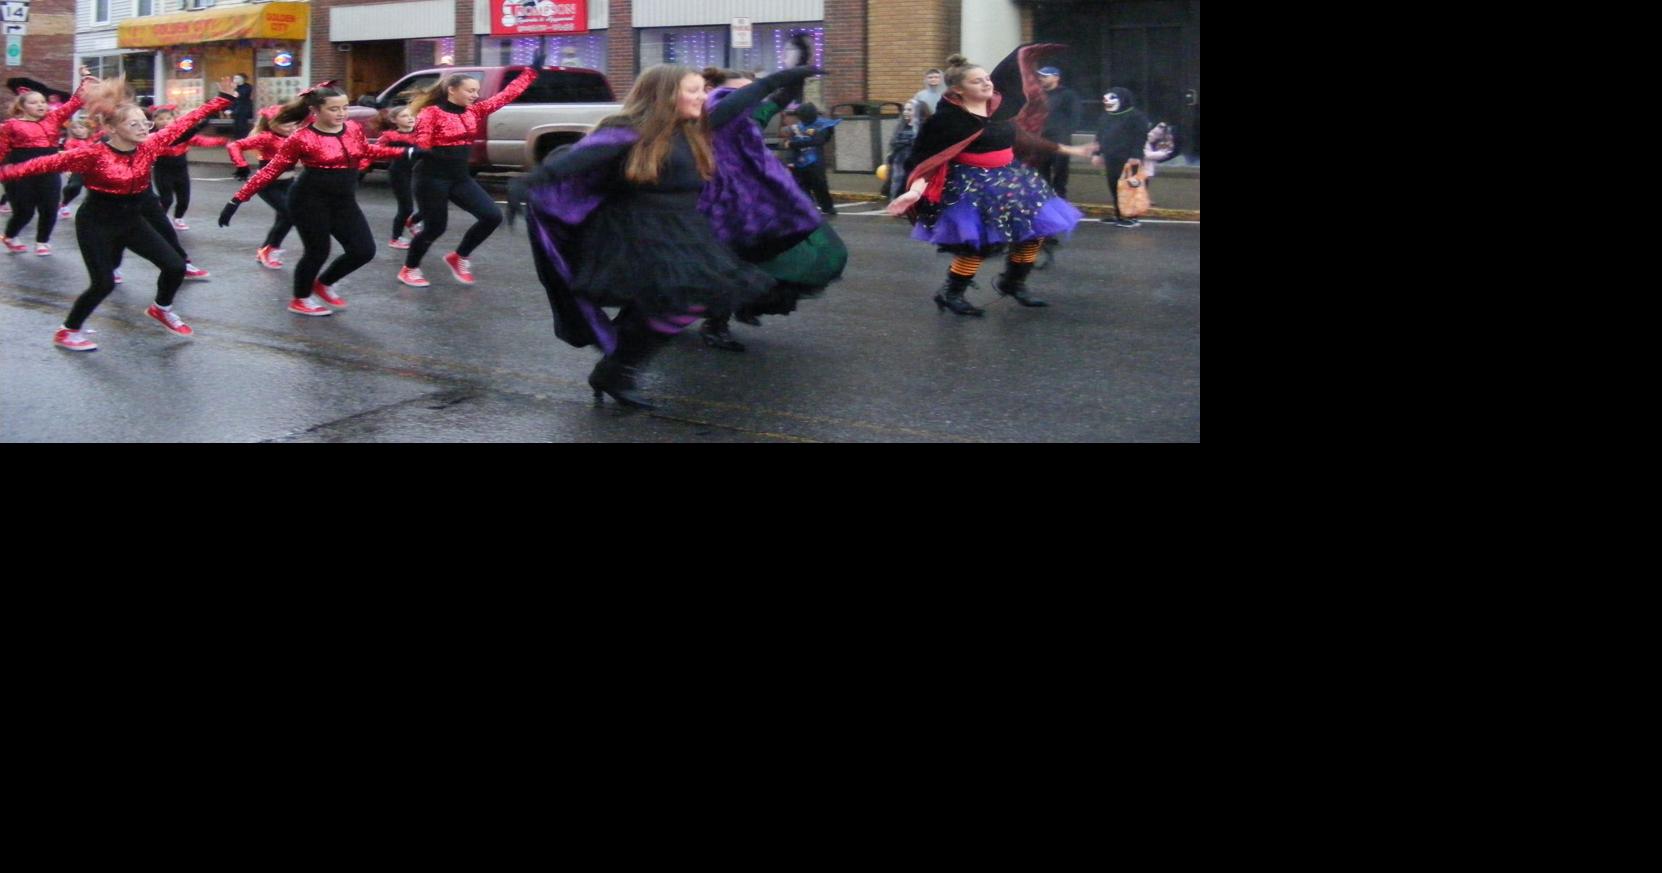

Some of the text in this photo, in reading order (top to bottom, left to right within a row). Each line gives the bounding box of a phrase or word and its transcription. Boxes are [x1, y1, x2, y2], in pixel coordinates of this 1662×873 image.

[7, 6, 24, 17] 14
[266, 13, 296, 23] GOLDEN
[270, 23, 289, 32] CITY
